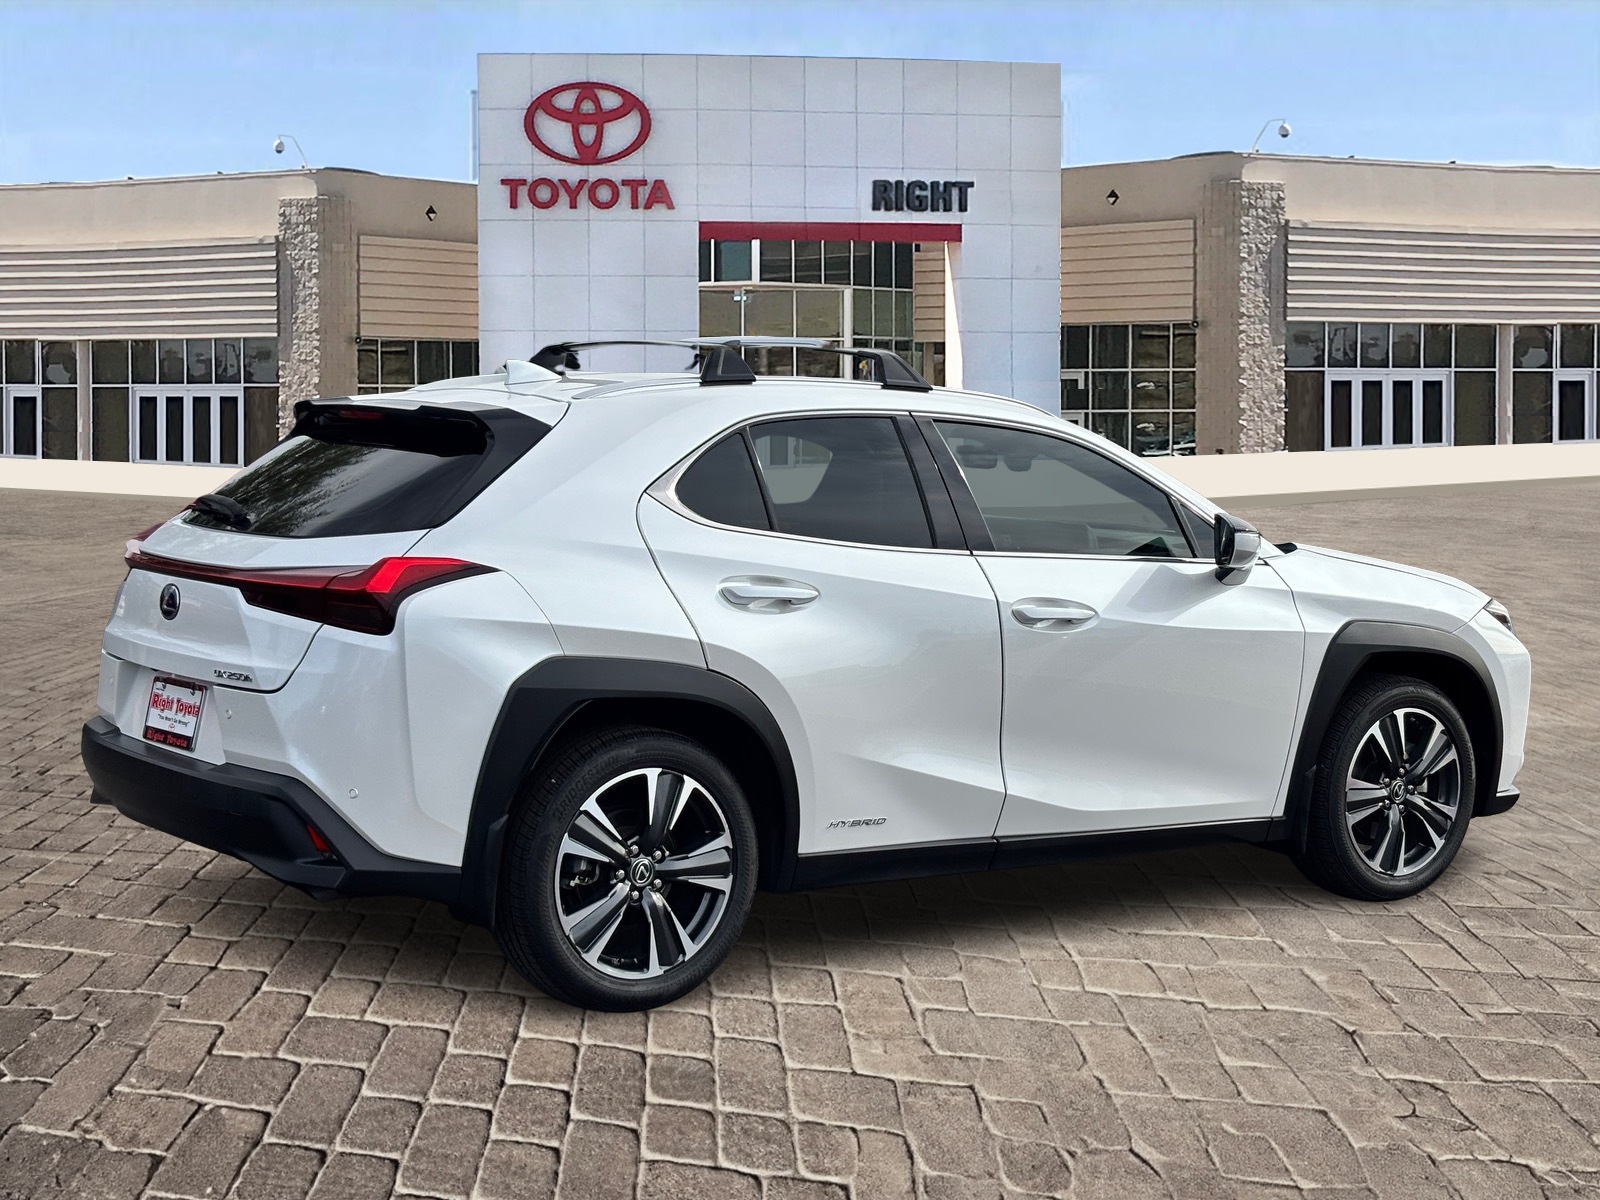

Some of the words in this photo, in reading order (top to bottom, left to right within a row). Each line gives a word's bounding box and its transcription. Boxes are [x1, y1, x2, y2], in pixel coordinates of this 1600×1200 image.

[501, 178, 675, 209] TOYOTA
[872, 179, 975, 212] RIGHT
[152, 692, 174, 713] Right
[175, 697, 200, 718] Toyota
[146, 730, 164, 742] Right
[166, 734, 188, 748] Toyota
[827, 817, 887, 828] HYBRID
